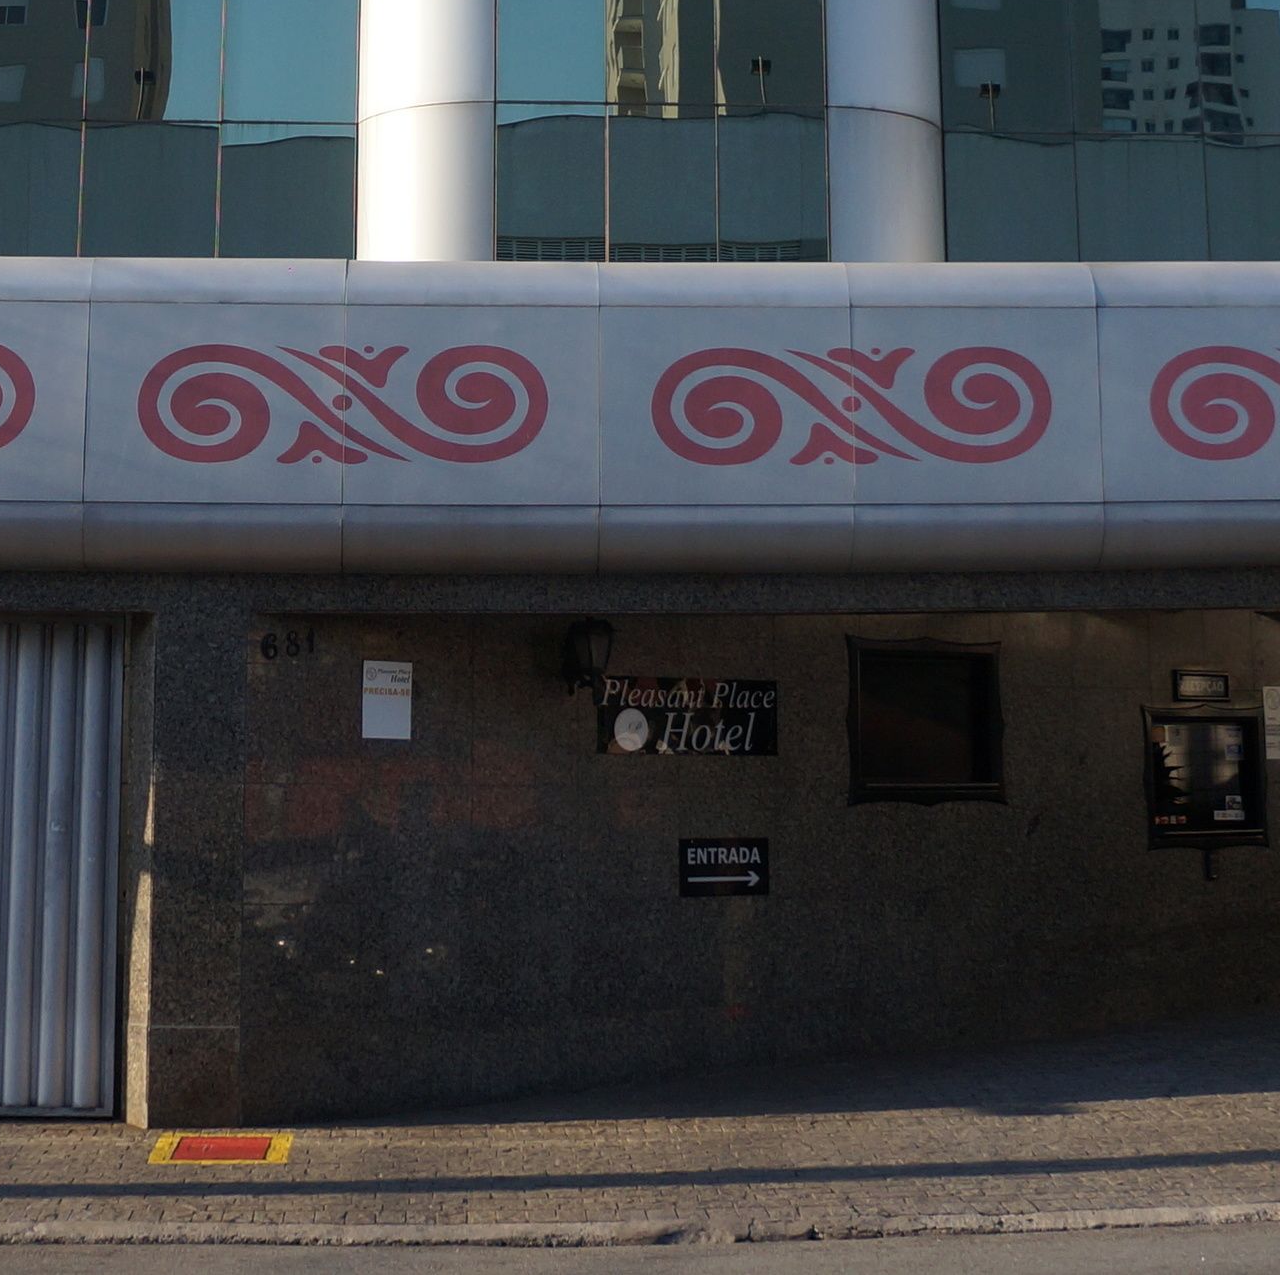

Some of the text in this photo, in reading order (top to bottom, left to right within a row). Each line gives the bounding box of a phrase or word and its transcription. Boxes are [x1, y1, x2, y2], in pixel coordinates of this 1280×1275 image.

[261, 628, 315, 660] 681
[599, 678, 776, 709] Pleasant Place
[663, 712, 756, 751] Hotel
[687, 846, 761, 864] ENTRADA
